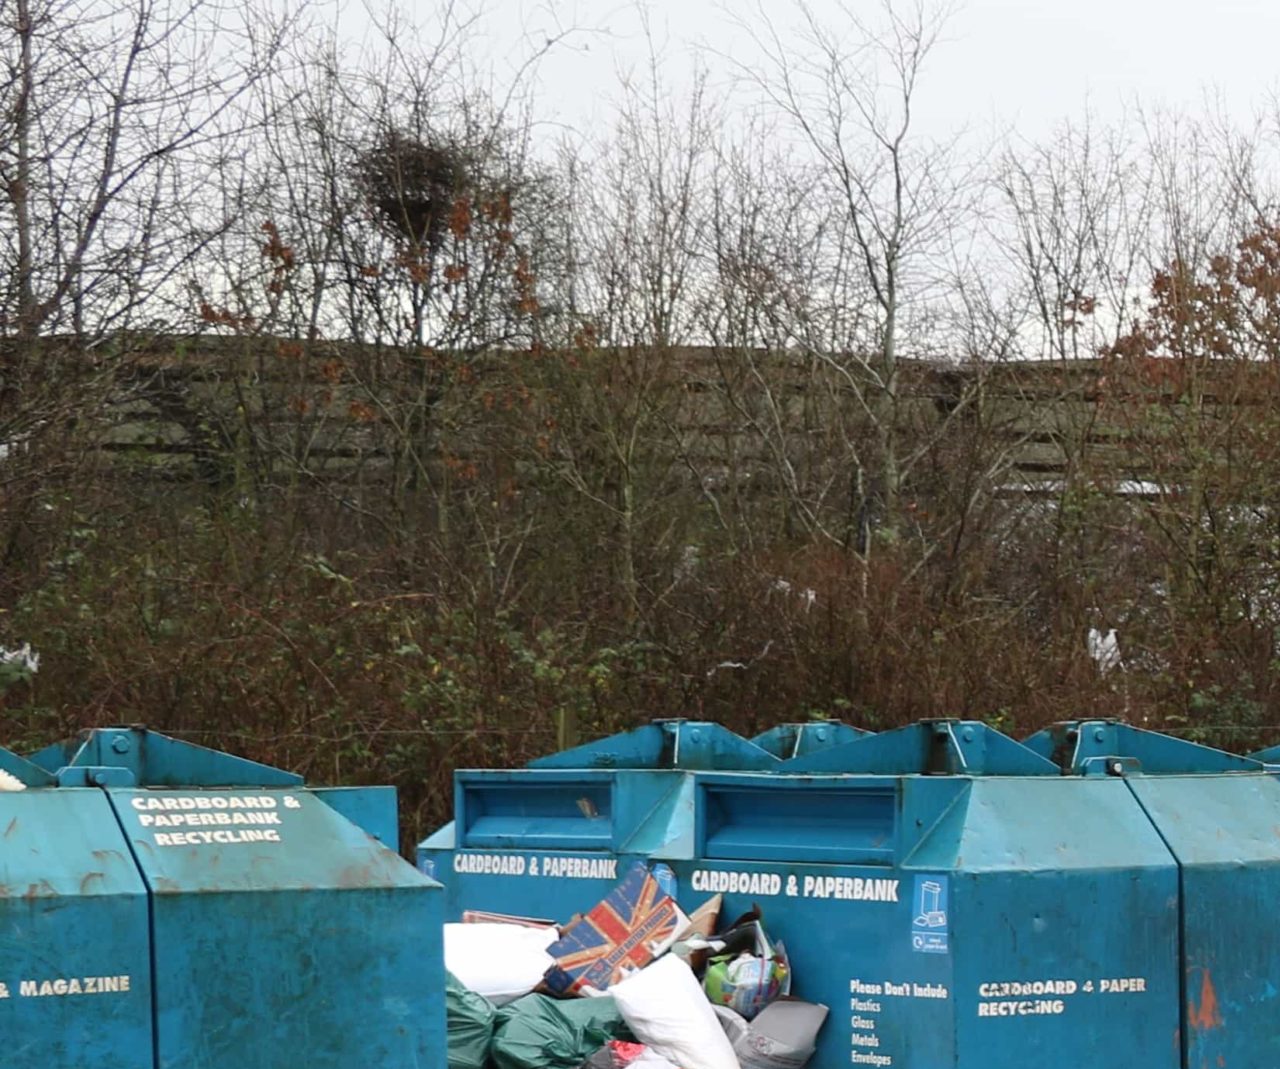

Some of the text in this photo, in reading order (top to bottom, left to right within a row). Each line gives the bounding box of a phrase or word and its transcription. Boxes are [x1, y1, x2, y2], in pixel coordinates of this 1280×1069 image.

[131, 795, 301, 810] CARDBOARD &
[138, 812, 282, 827] PAPERBANK
[154, 829, 281, 846] RECYCLING
[454, 854, 618, 879] CARDBOARD & PAPERBANK
[691, 870, 899, 902] CARDBOARD & PAPERBANK
[0, 975, 130, 998] & MAGAZINE
[850, 979, 948, 999] Please Don't Include
[979, 978, 1146, 997] CARDBOARD & PAPER
[850, 998, 881, 1012] Plastics
[851, 1015, 875, 1029] Glass
[851, 1033, 879, 1047] Metals
[851, 1050, 892, 1067] Envelopes
